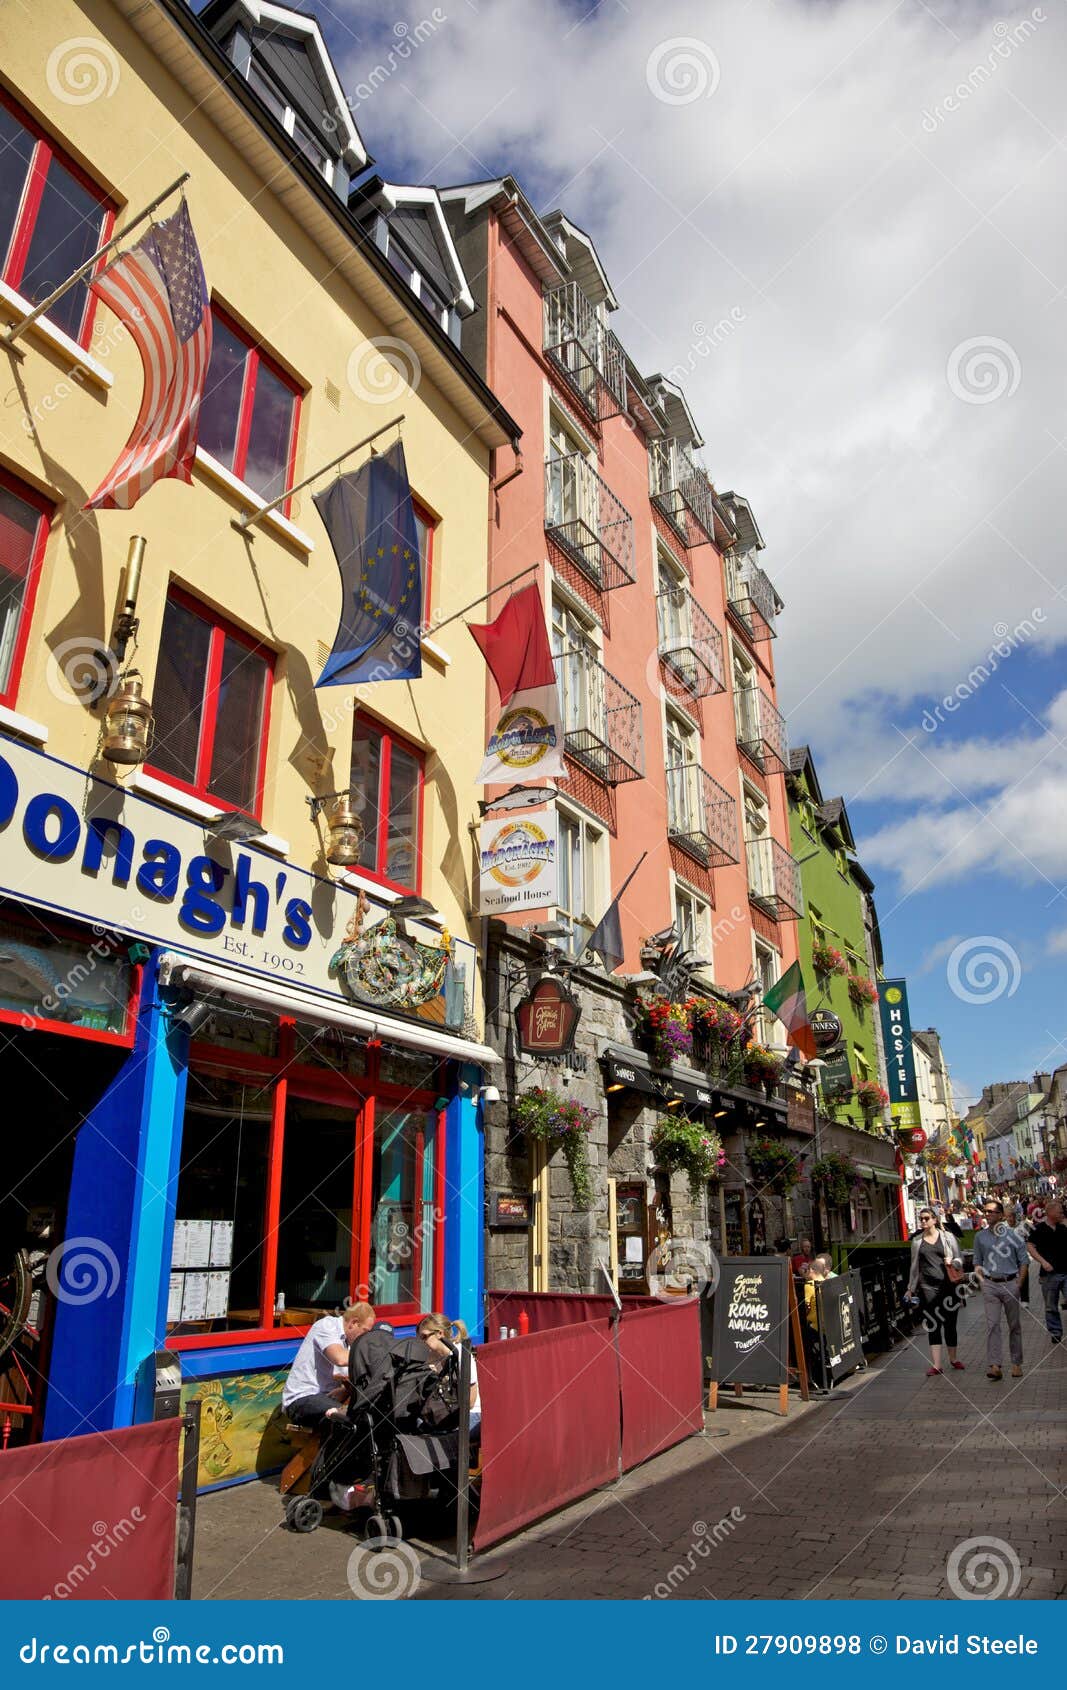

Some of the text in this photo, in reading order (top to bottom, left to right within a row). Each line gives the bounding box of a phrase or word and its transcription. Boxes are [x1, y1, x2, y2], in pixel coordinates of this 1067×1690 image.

[484, 890, 552, 906] Seafood House
[223, 935, 306, 976] Est. 1902
[811, 1022, 839, 1031] INNESS
[889, 1009, 909, 1097] HOSTEL
[728, 1303, 769, 1320] ROOMS
[728, 1319, 771, 1332] AVAILABLE
